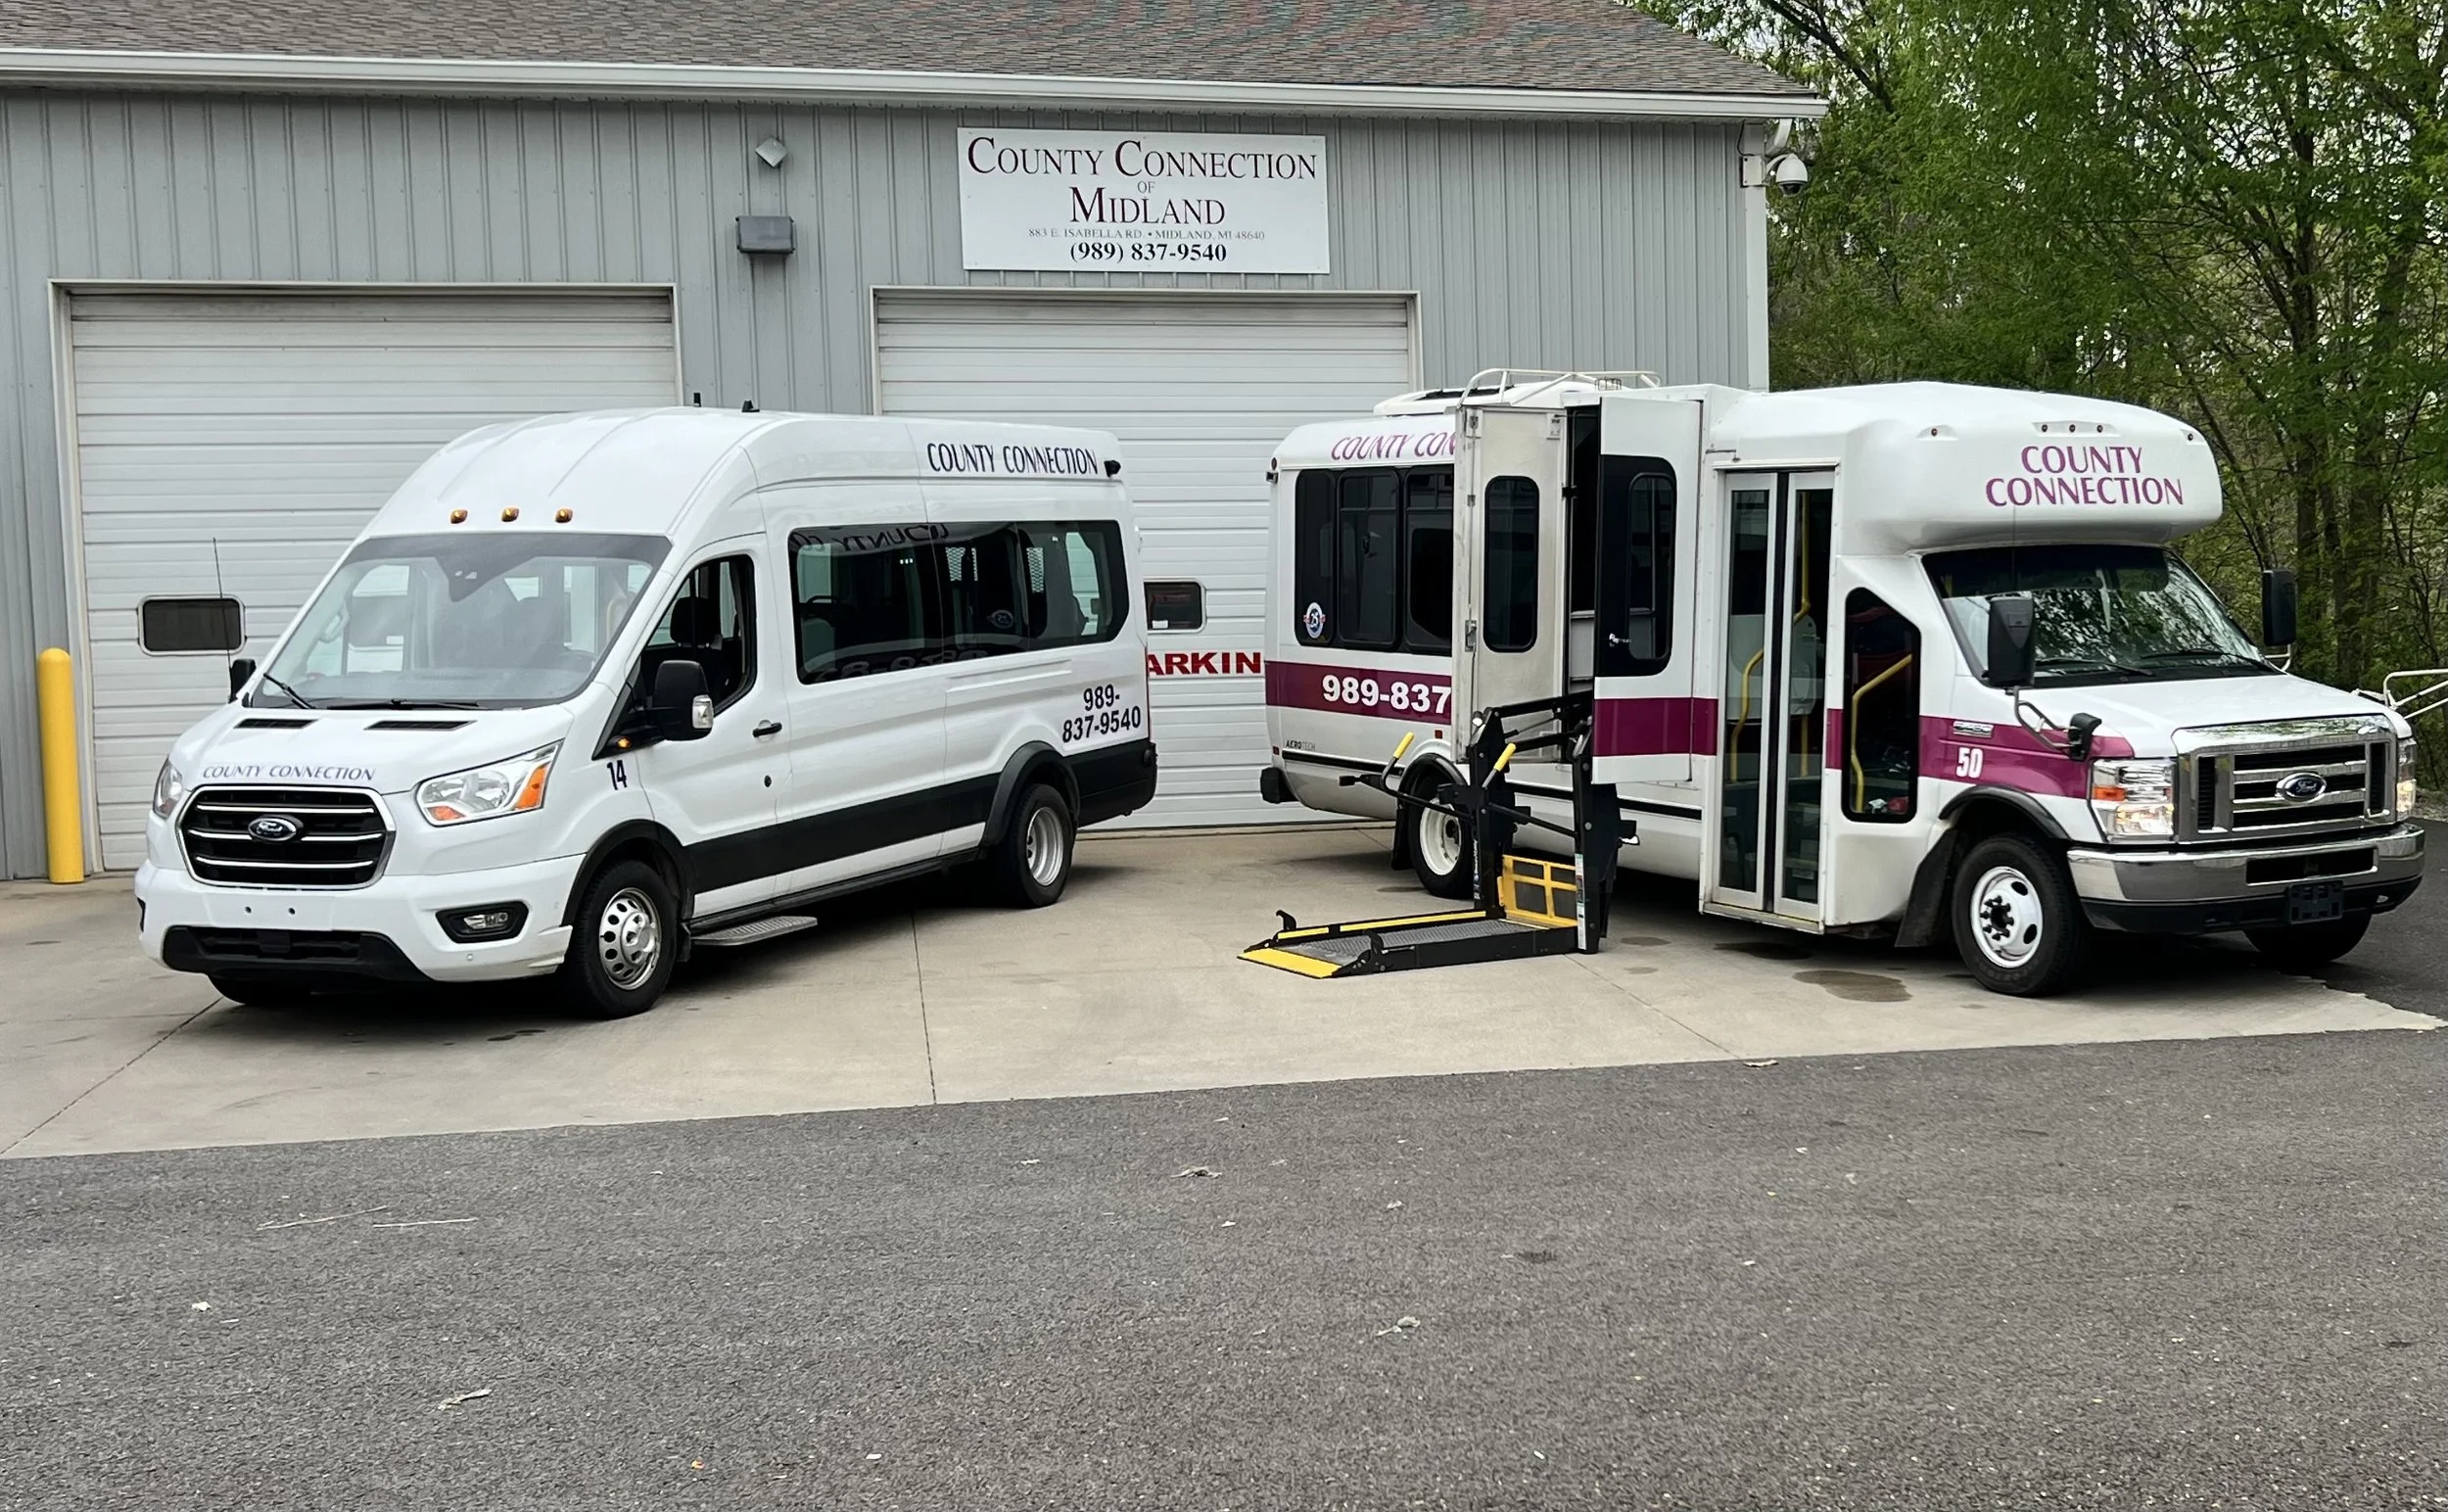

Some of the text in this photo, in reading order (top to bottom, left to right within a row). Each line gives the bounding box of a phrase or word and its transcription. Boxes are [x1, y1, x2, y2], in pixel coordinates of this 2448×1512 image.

[967, 136, 1317, 180] COUNTY CONNECTION
[1136, 180, 1155, 194] OF
[1068, 186, 1226, 225] MIDLAND
[1028, 228, 1048, 237] 883
[1064, 228, 1122, 239] ISABELLA
[1217, 231, 1233, 241] MI
[1235, 231, 1265, 241] 48640
[1070, 242, 1227, 263] (989) 837-9540
[927, 443, 1098, 475] COUNTY CONNECTION
[1331, 434, 1415, 460] COUNTY
[2021, 446, 2142, 474] COUNTY
[1985, 477, 2184, 506] CONNECTION
[1083, 684, 1120, 711] 989-
[1062, 705, 1142, 743] 837-9540
[203, 766, 377, 781] COUNTY CONNECTION
[606, 759, 628, 791] 14
[1956, 746, 1984, 779] 50
